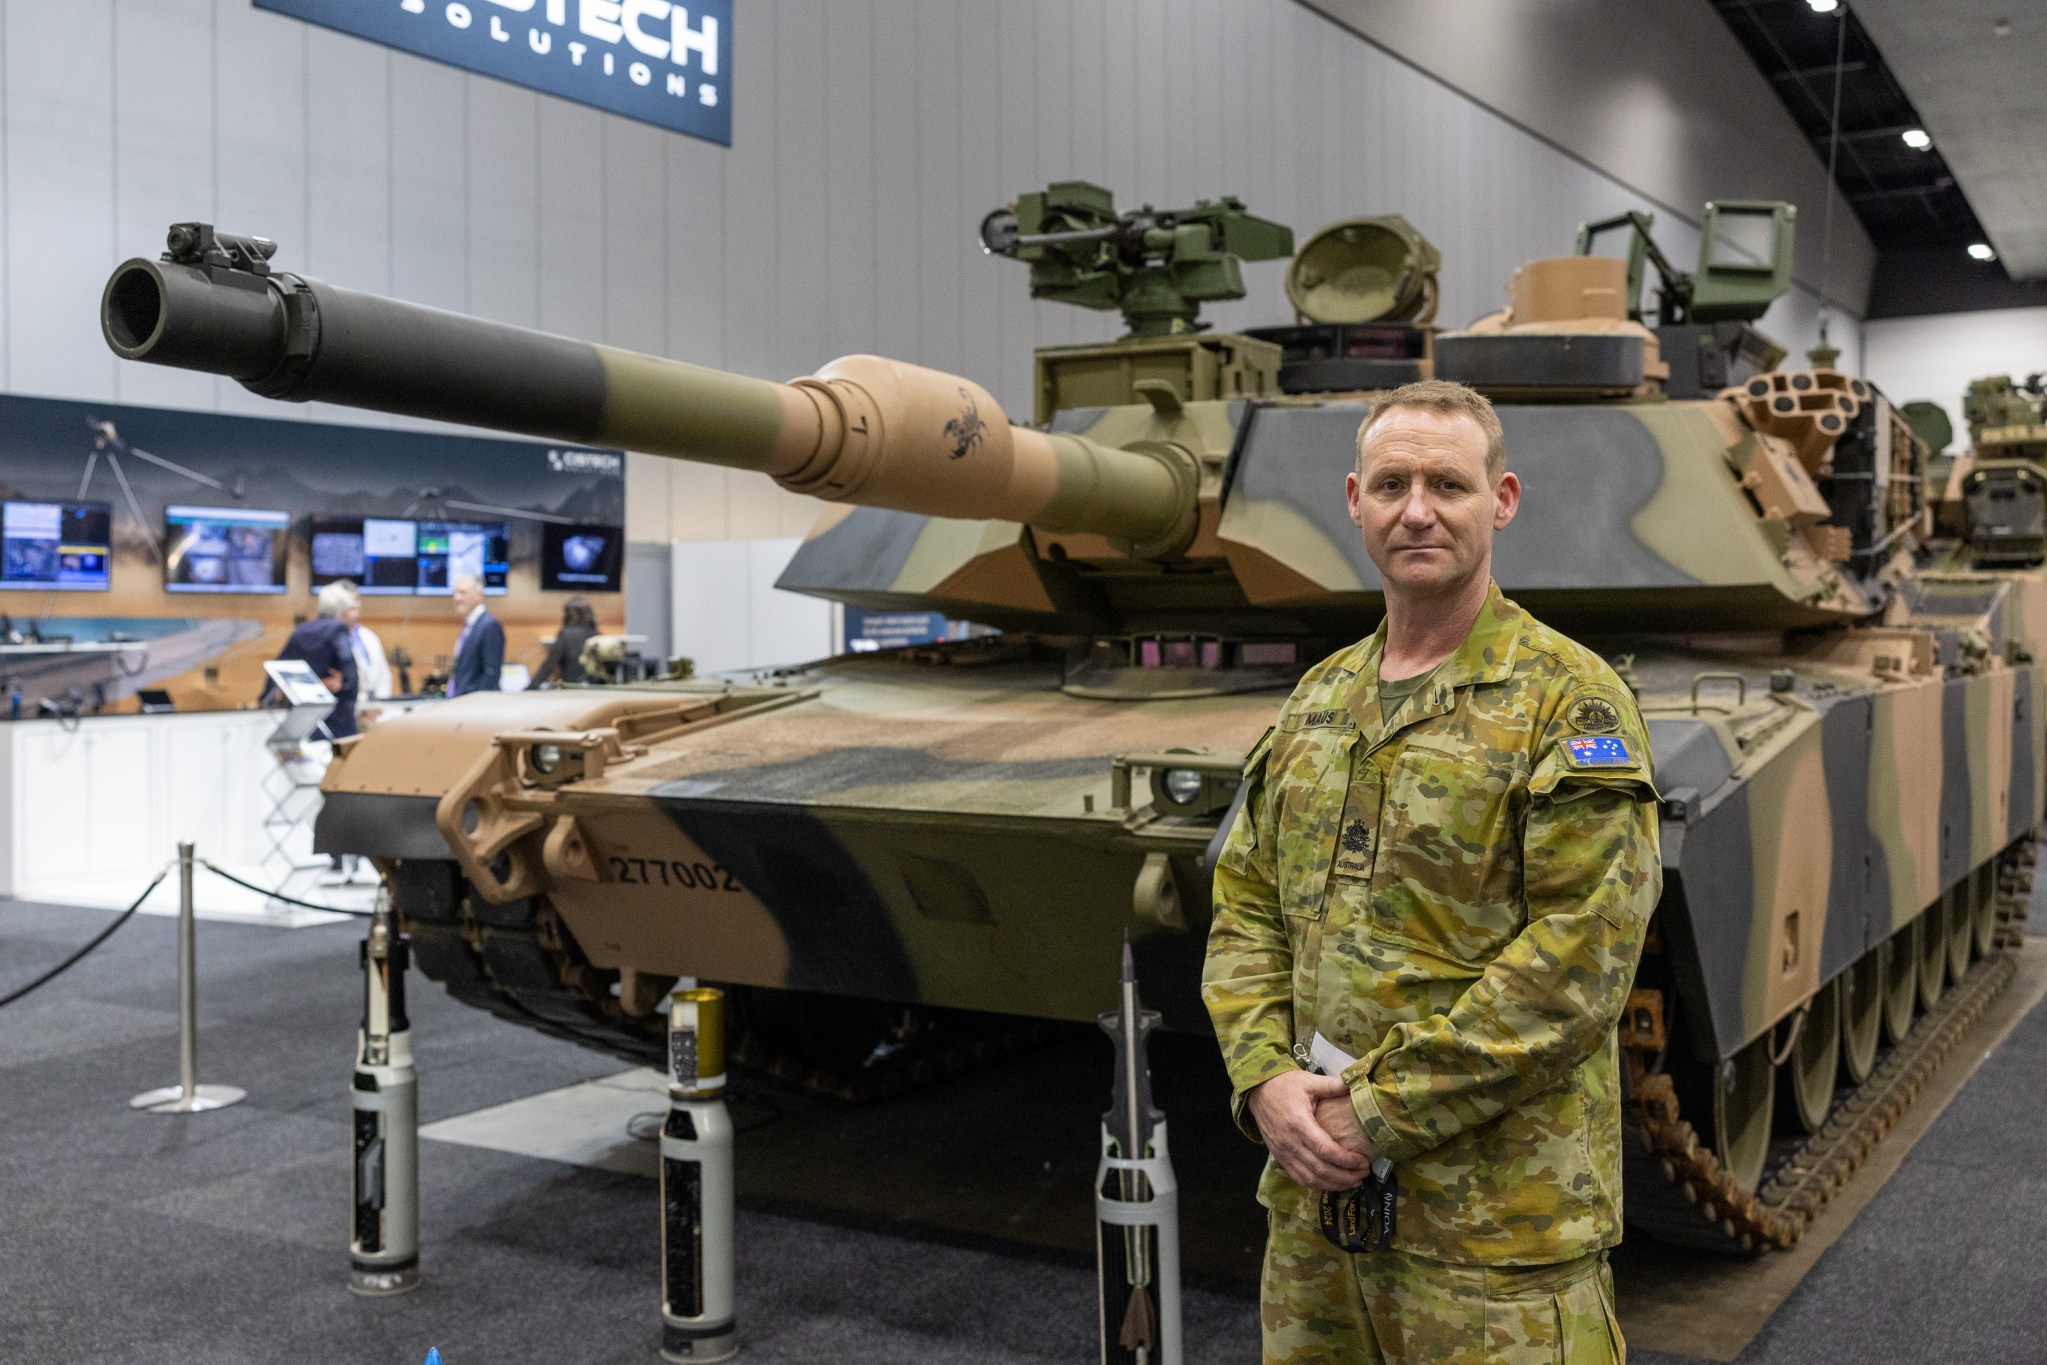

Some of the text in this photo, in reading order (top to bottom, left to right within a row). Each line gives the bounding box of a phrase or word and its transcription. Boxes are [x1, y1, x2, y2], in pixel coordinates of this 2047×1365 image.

[482, 0, 718, 76] TECH
[1304, 711, 1335, 726] MAUS
[609, 856, 741, 892] 277002
[1336, 861, 1365, 872] AUSTRALIA
[1323, 1205, 1333, 1226] 2024
[1348, 1217, 1356, 1236] Land
